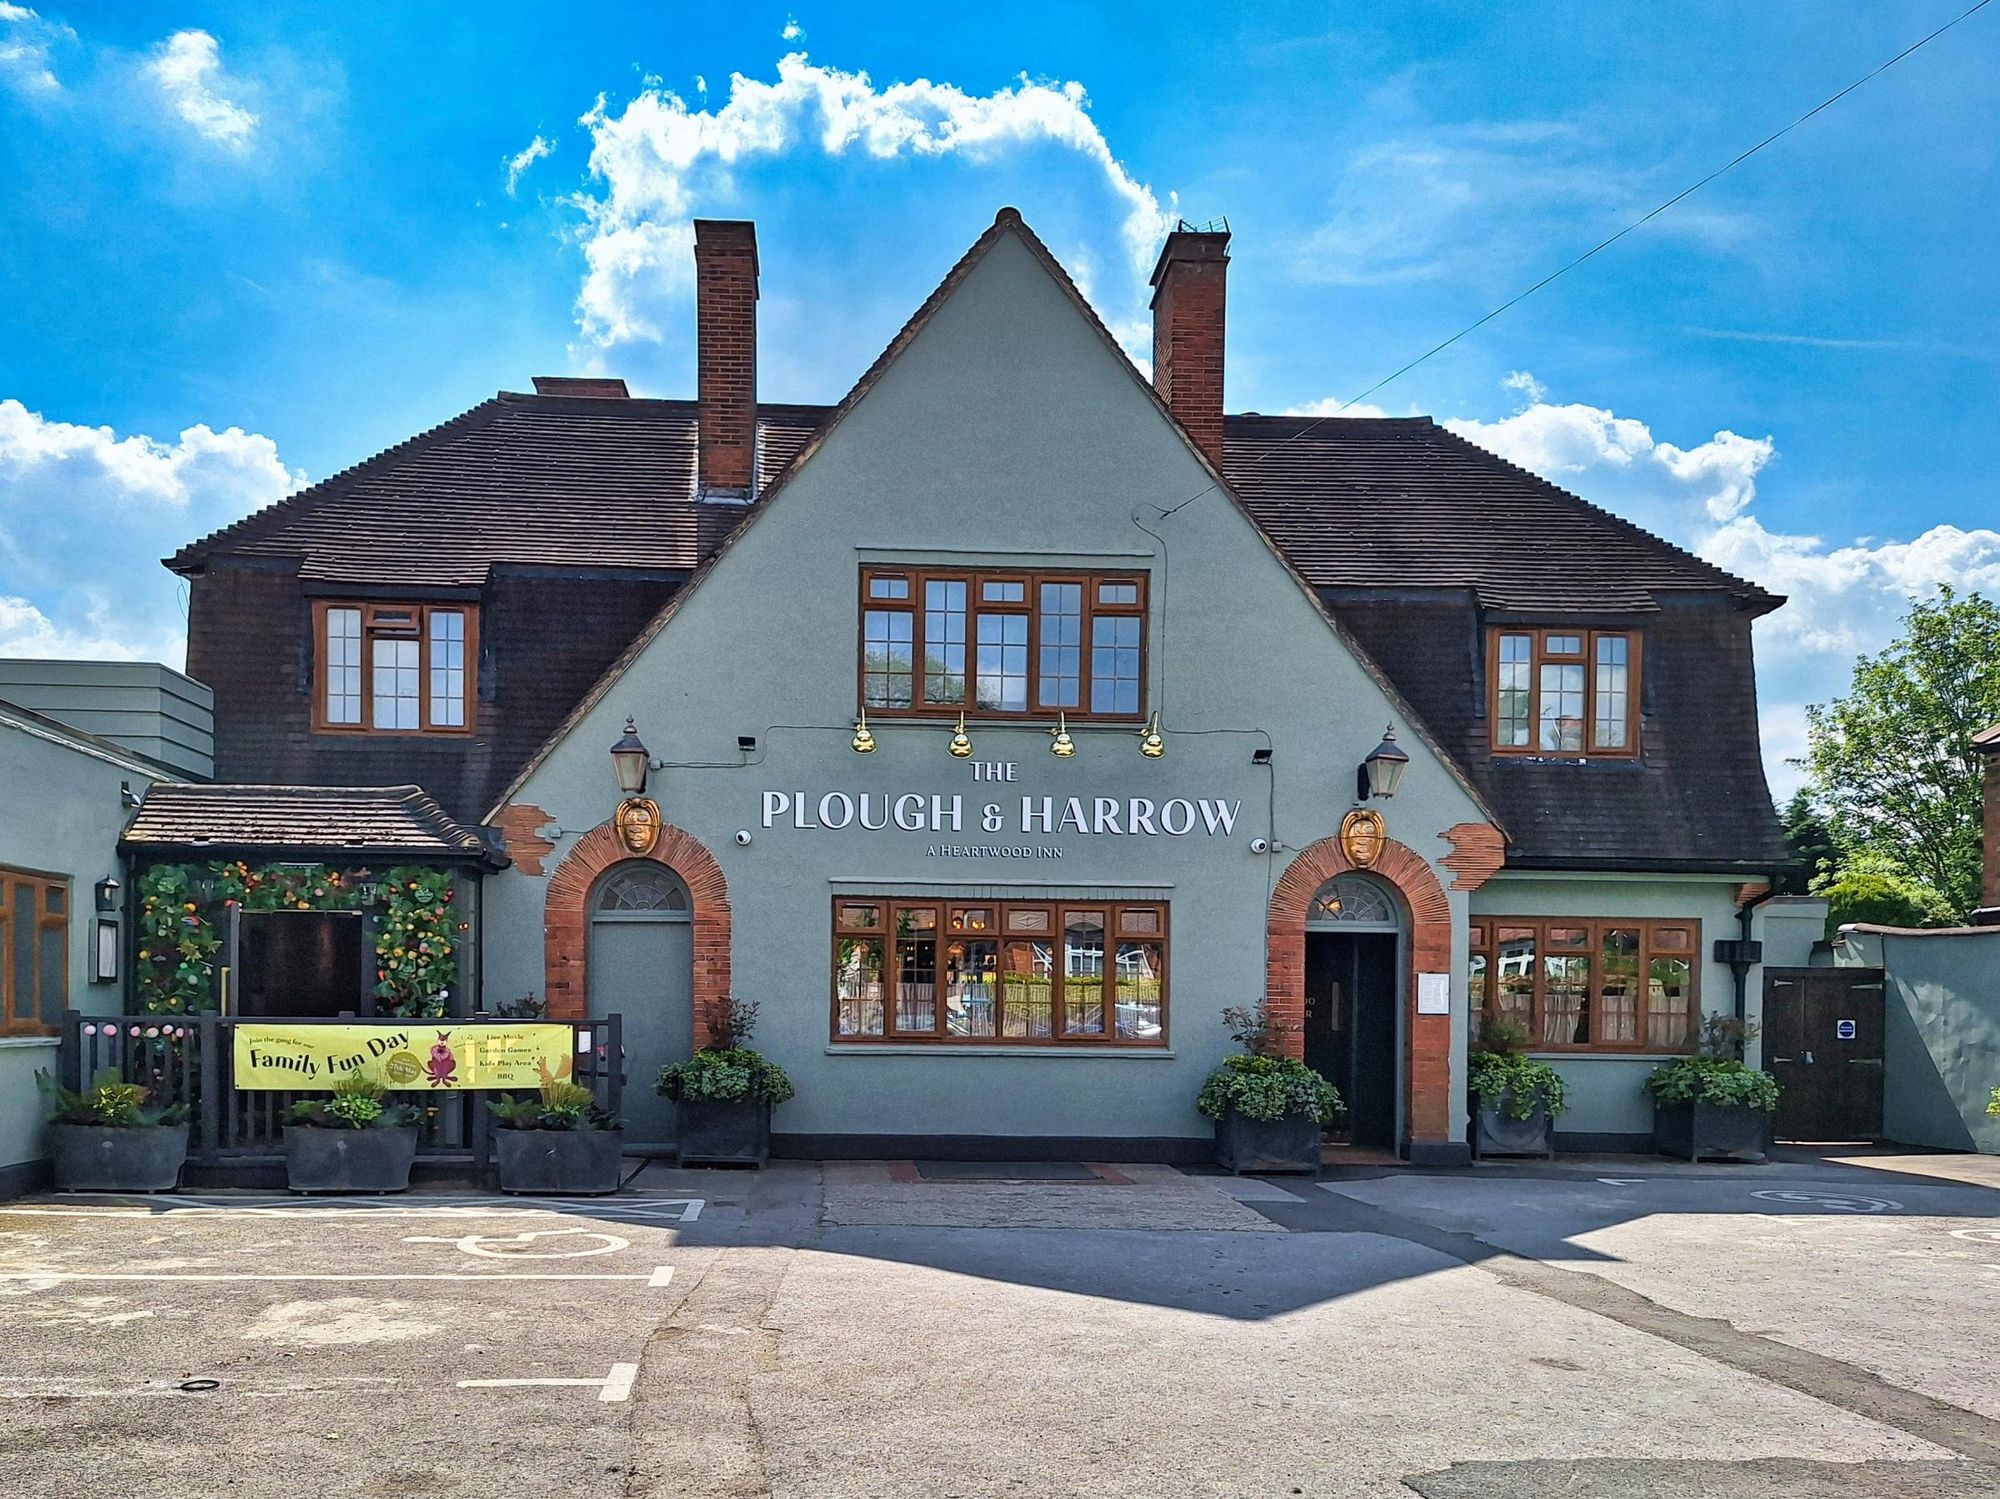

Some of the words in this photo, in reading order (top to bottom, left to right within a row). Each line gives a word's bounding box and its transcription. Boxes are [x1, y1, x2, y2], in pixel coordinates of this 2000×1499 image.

[970, 761, 1019, 782] THE
[762, 791, 963, 831] PLOUGH
[981, 803, 1004, 833] &
[1021, 796, 1242, 836] HARROW
[925, 845, 937, 857] A
[940, 845, 1032, 858] HEARTWOOD
[1036, 846, 1063, 859] INN
[250, 1049, 320, 1080] Family
[327, 1053, 365, 1074] Fun
[366, 1031, 409, 1057] Day
[497, 1060, 512, 1068] Play
[514, 1059, 532, 1067] Area
[497, 1073, 515, 1081] BBQ
